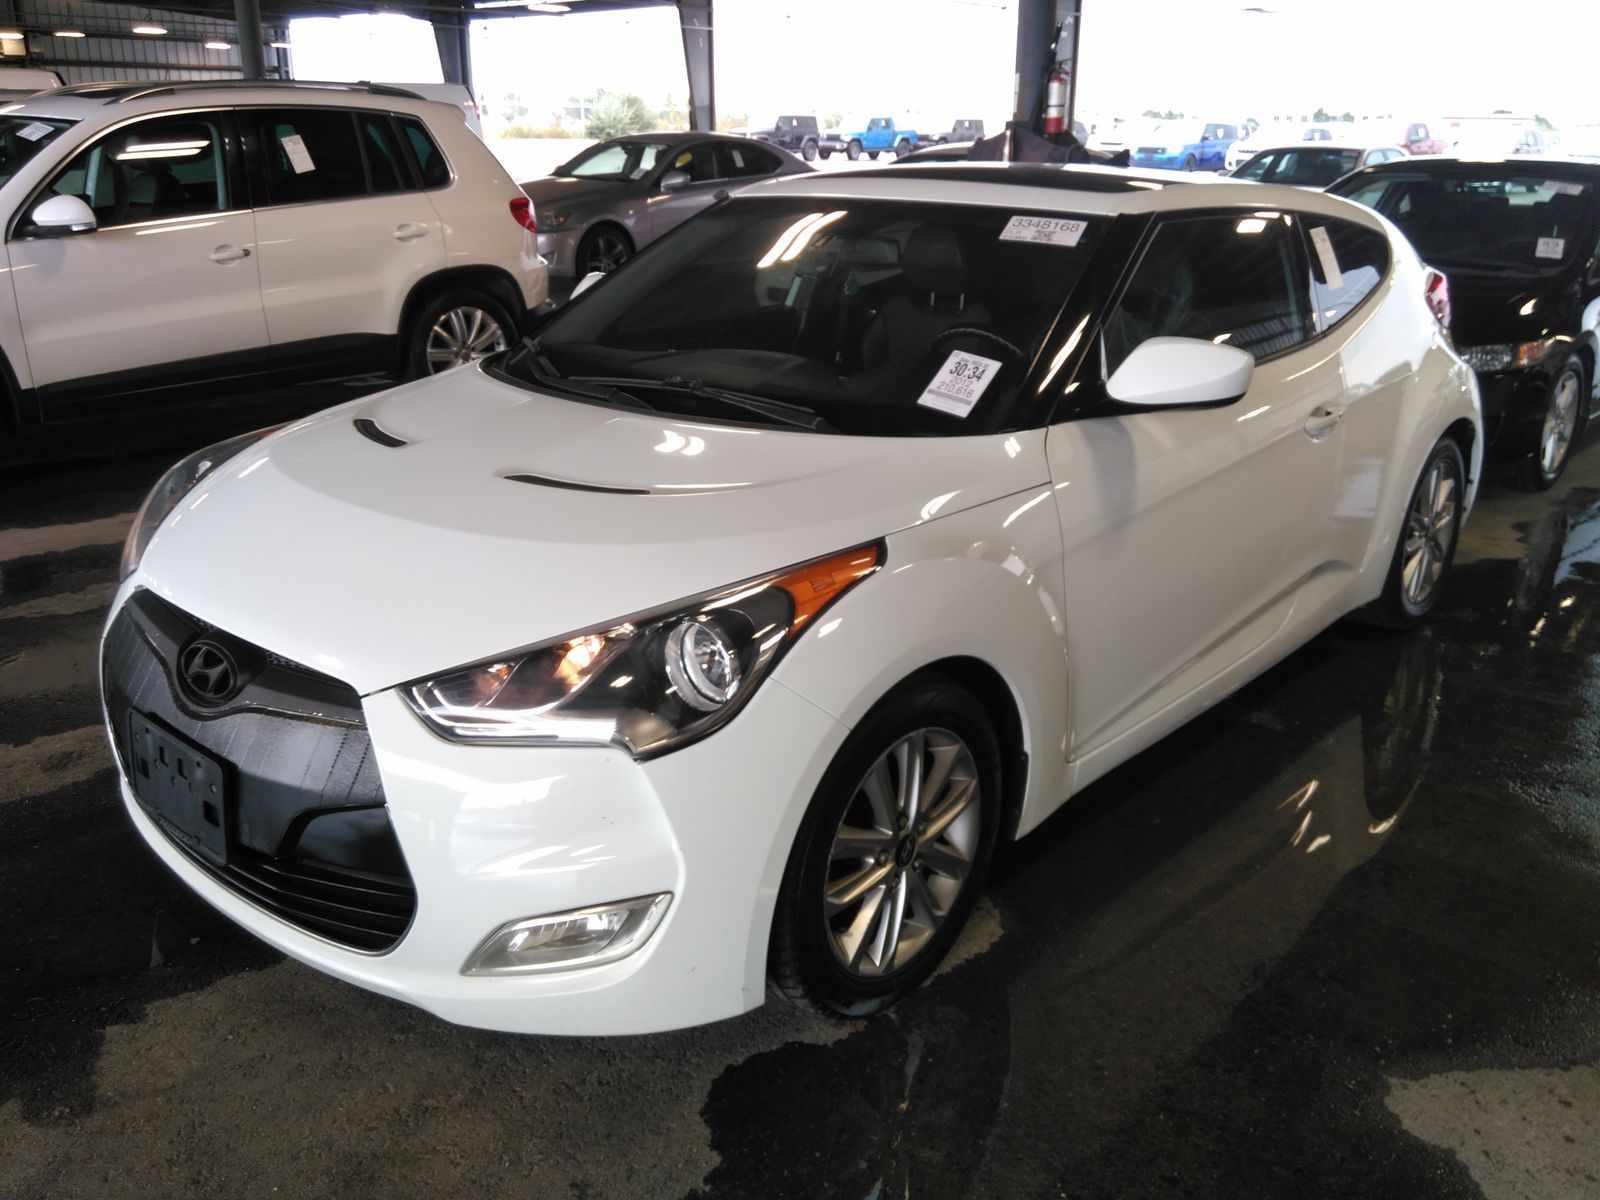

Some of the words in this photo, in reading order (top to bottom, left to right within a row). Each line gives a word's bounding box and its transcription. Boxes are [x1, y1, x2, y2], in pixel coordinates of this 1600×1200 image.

[1012, 217, 1081, 233] 3348168
[949, 361, 986, 382] 30:34
[948, 376, 974, 388] 2012
